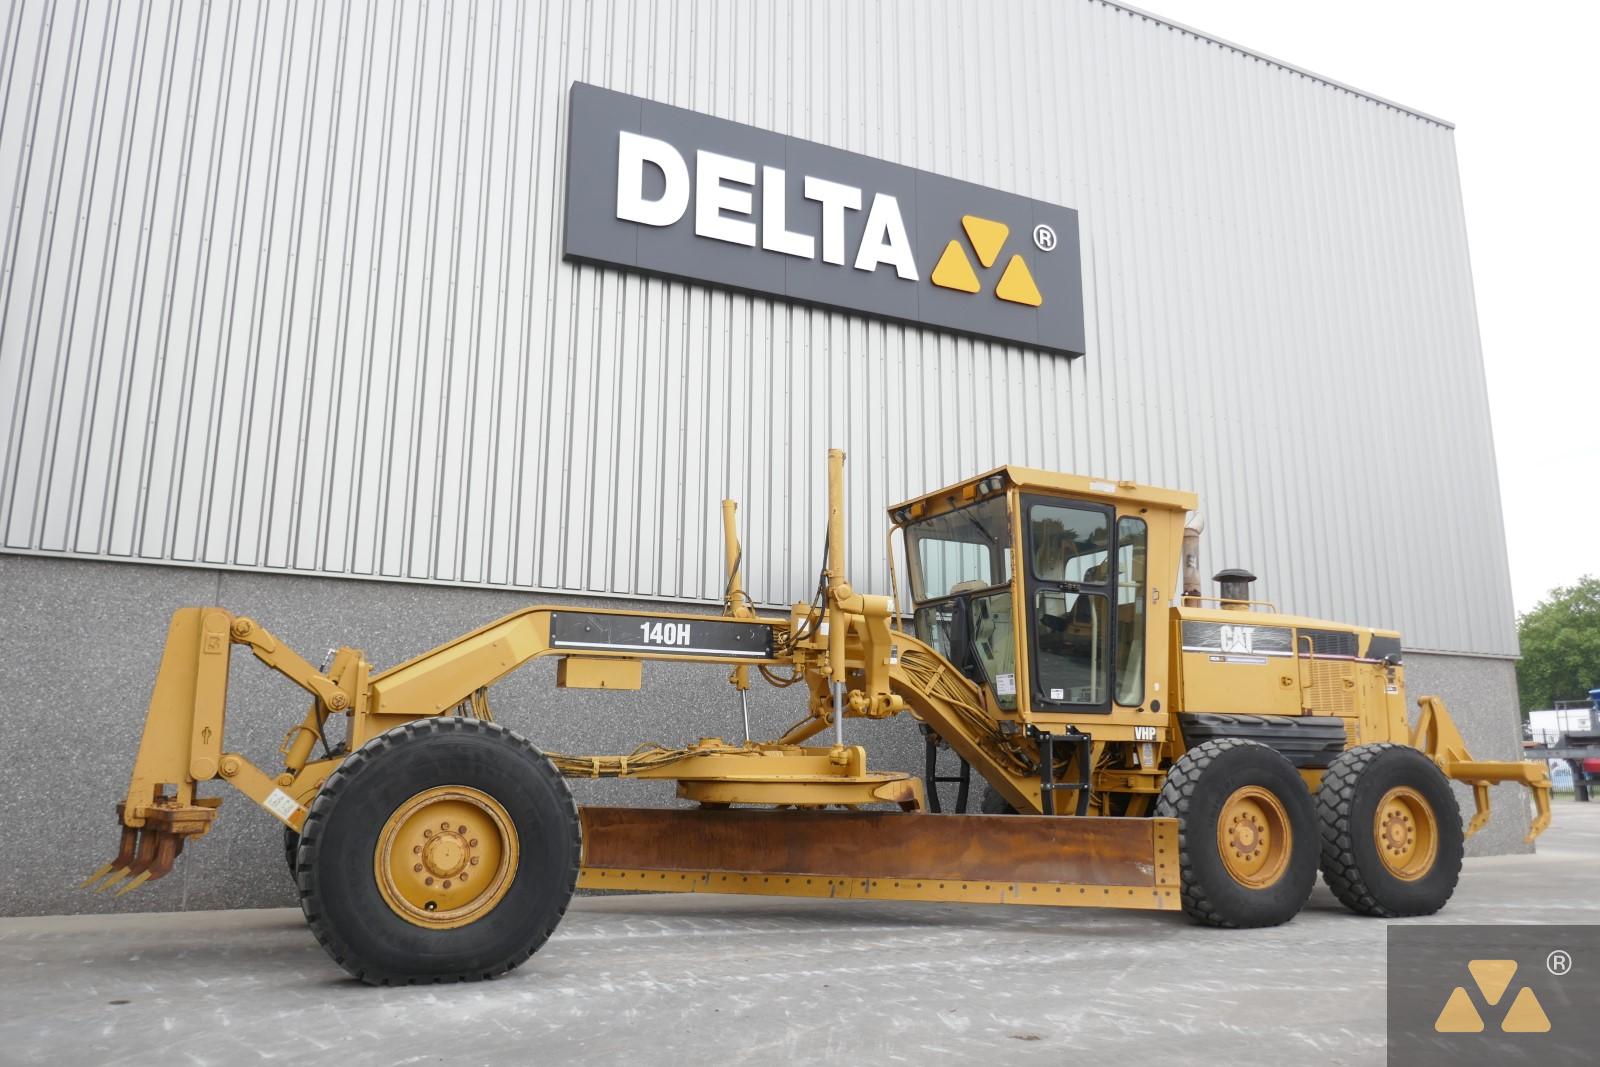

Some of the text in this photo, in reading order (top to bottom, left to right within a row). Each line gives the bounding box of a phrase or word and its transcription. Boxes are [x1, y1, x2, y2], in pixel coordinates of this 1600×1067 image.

[616, 130, 920, 282] DELTA
[640, 621, 691, 646] 140H
[1220, 624, 1255, 654] CAT
[1134, 726, 1156, 740] VHP
